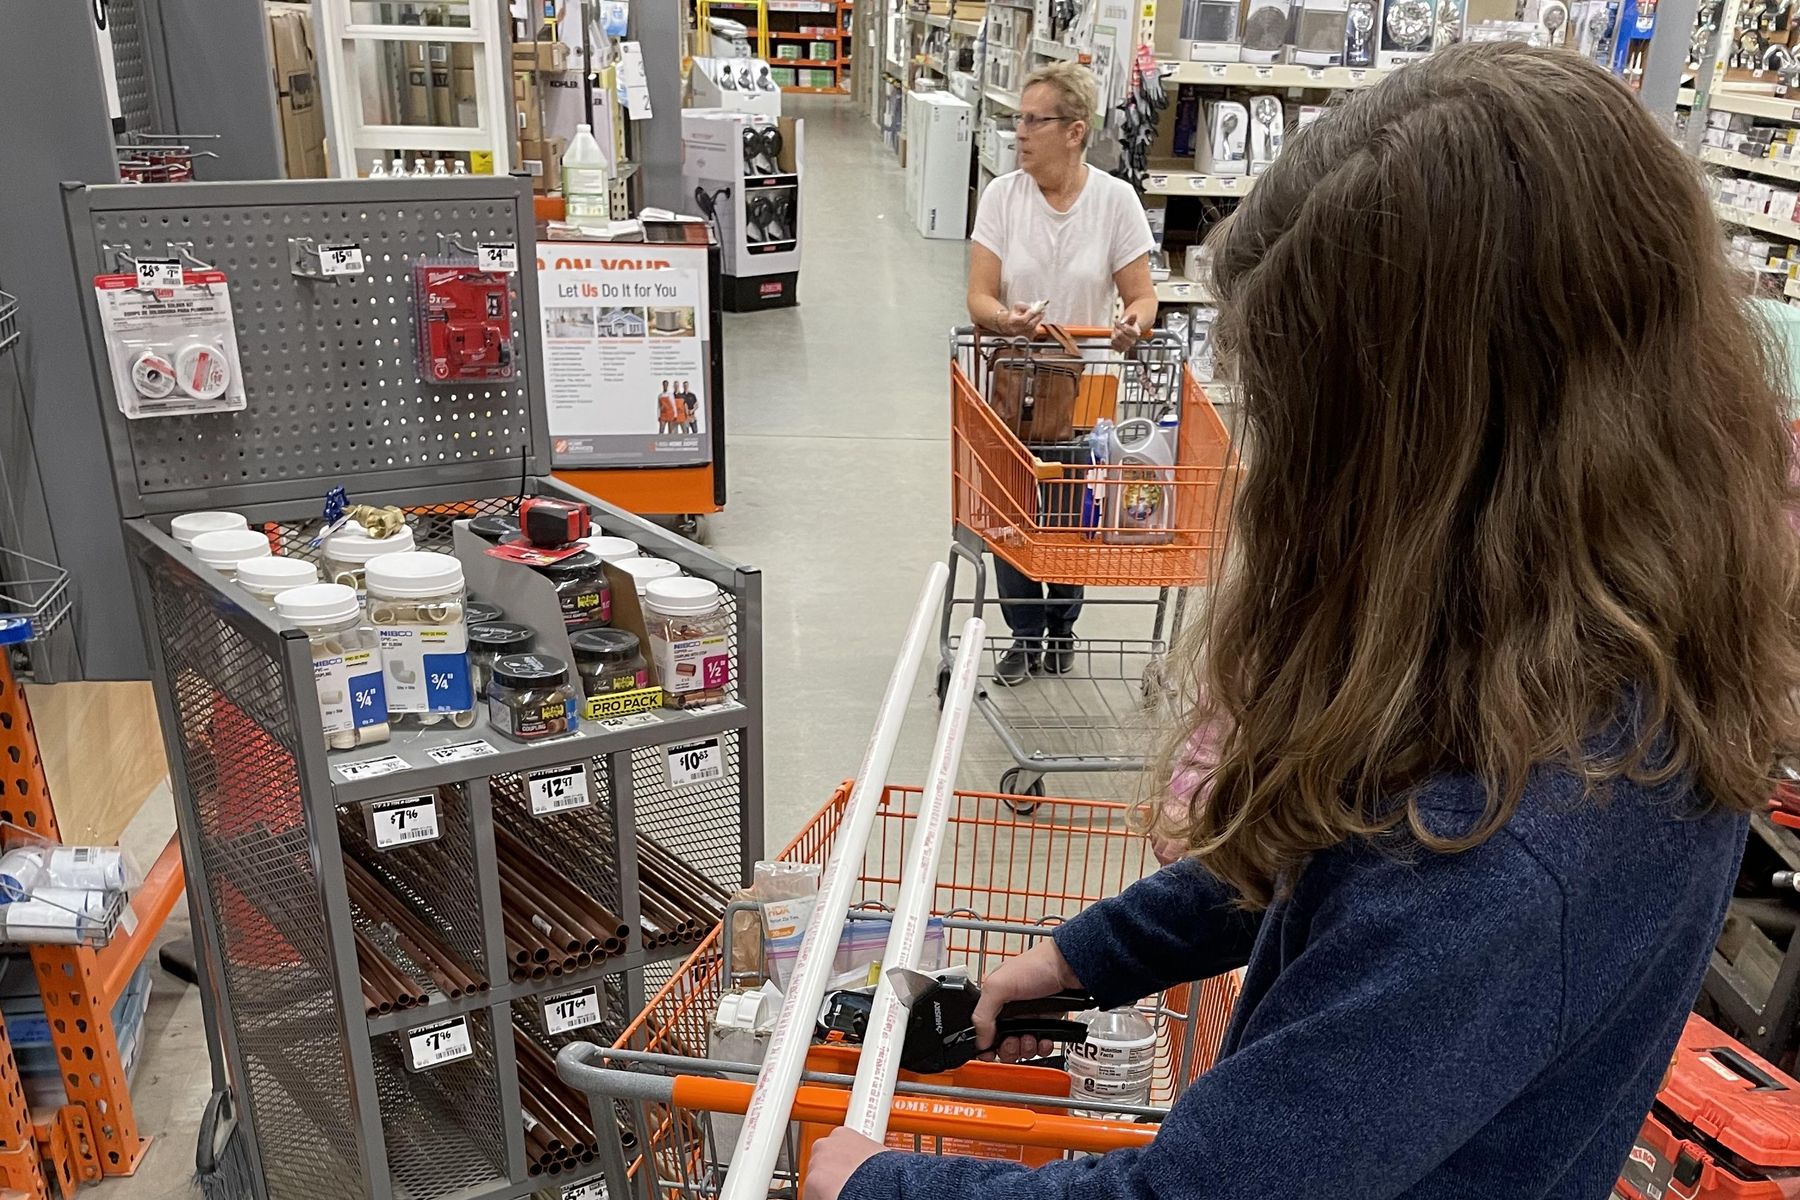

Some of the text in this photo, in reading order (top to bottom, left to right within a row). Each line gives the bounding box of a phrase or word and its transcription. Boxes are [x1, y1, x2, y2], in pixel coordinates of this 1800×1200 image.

[550, 80, 578, 89] KOHLER
[558, 283, 677, 298] Let Us Do It for You
[673, 641, 701, 650] NIBCO
[592, 695, 658, 714] PRO PACK
[933, 1001, 942, 1026] HUSKY
[891, 1101, 986, 1119] OME DEPOT
